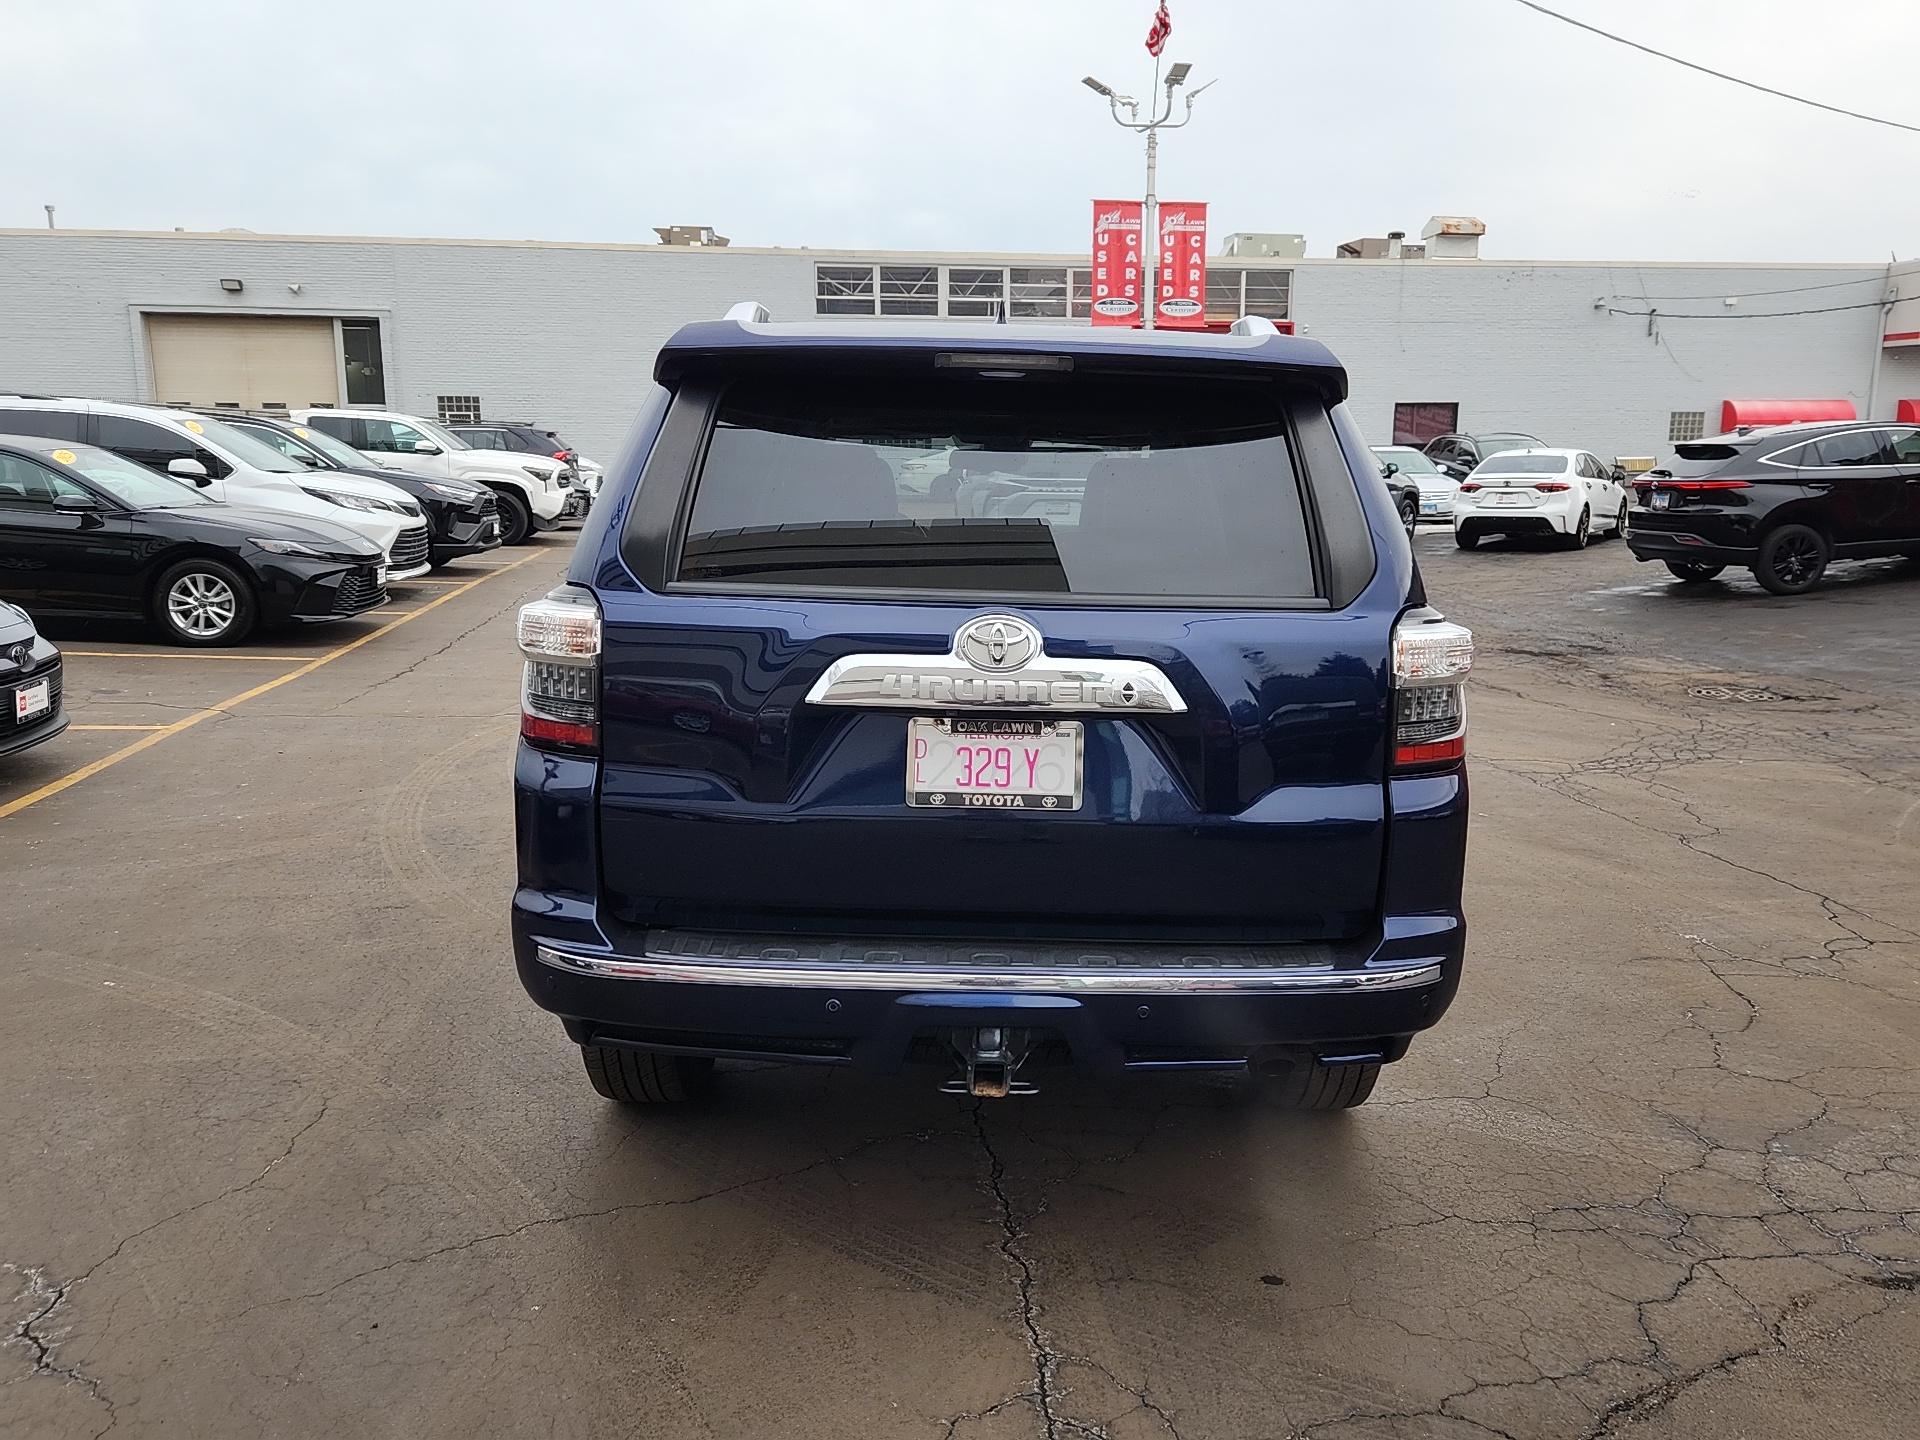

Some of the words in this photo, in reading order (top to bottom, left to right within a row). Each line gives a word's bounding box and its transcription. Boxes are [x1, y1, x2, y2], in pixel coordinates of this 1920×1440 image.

[1097, 233, 1109, 297] USED
[1125, 233, 1138, 297] CARS
[1162, 235, 1175, 297] USED
[1189, 235, 1202, 298] CARS
[957, 721, 988, 732] OAK
[992, 722, 1035, 734] LAWN
[956, 747, 1011, 788] 329
[1024, 748, 1040, 788] Y
[963, 794, 1024, 806] TOYOTA
